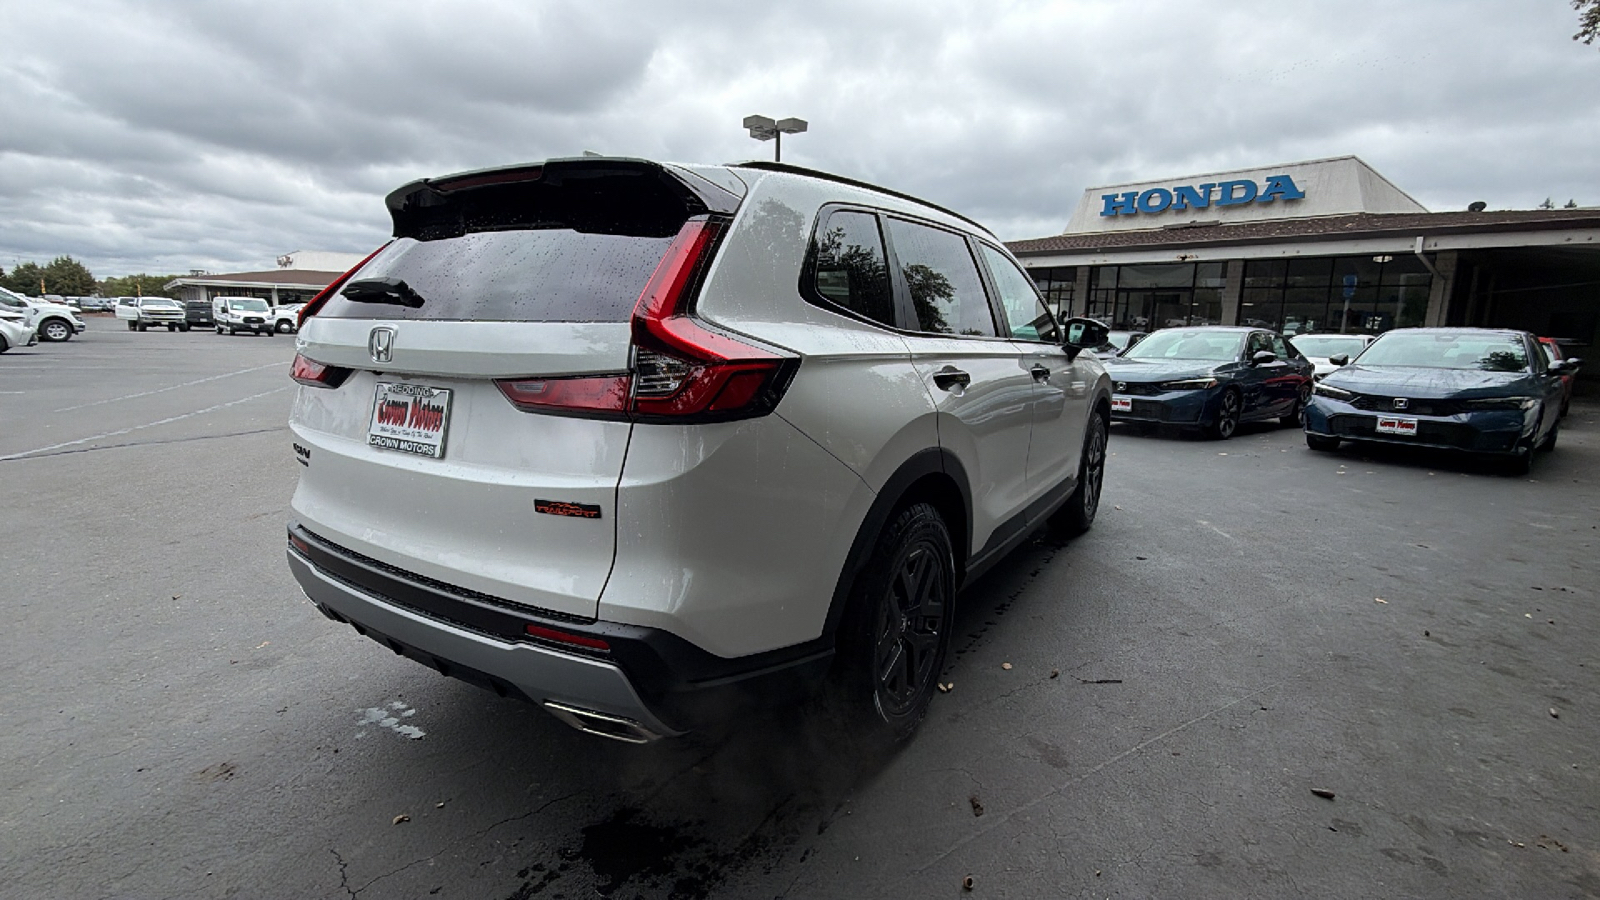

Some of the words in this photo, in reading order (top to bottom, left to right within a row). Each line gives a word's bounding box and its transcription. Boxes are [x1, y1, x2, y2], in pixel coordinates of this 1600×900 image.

[1100, 174, 1306, 217] HONDA
[391, 384, 430, 397] REDDING
[378, 400, 408, 427] Crown
[408, 396, 444, 433] Motors
[370, 436, 399, 449] CROWN
[400, 441, 434, 455] MOTORS
